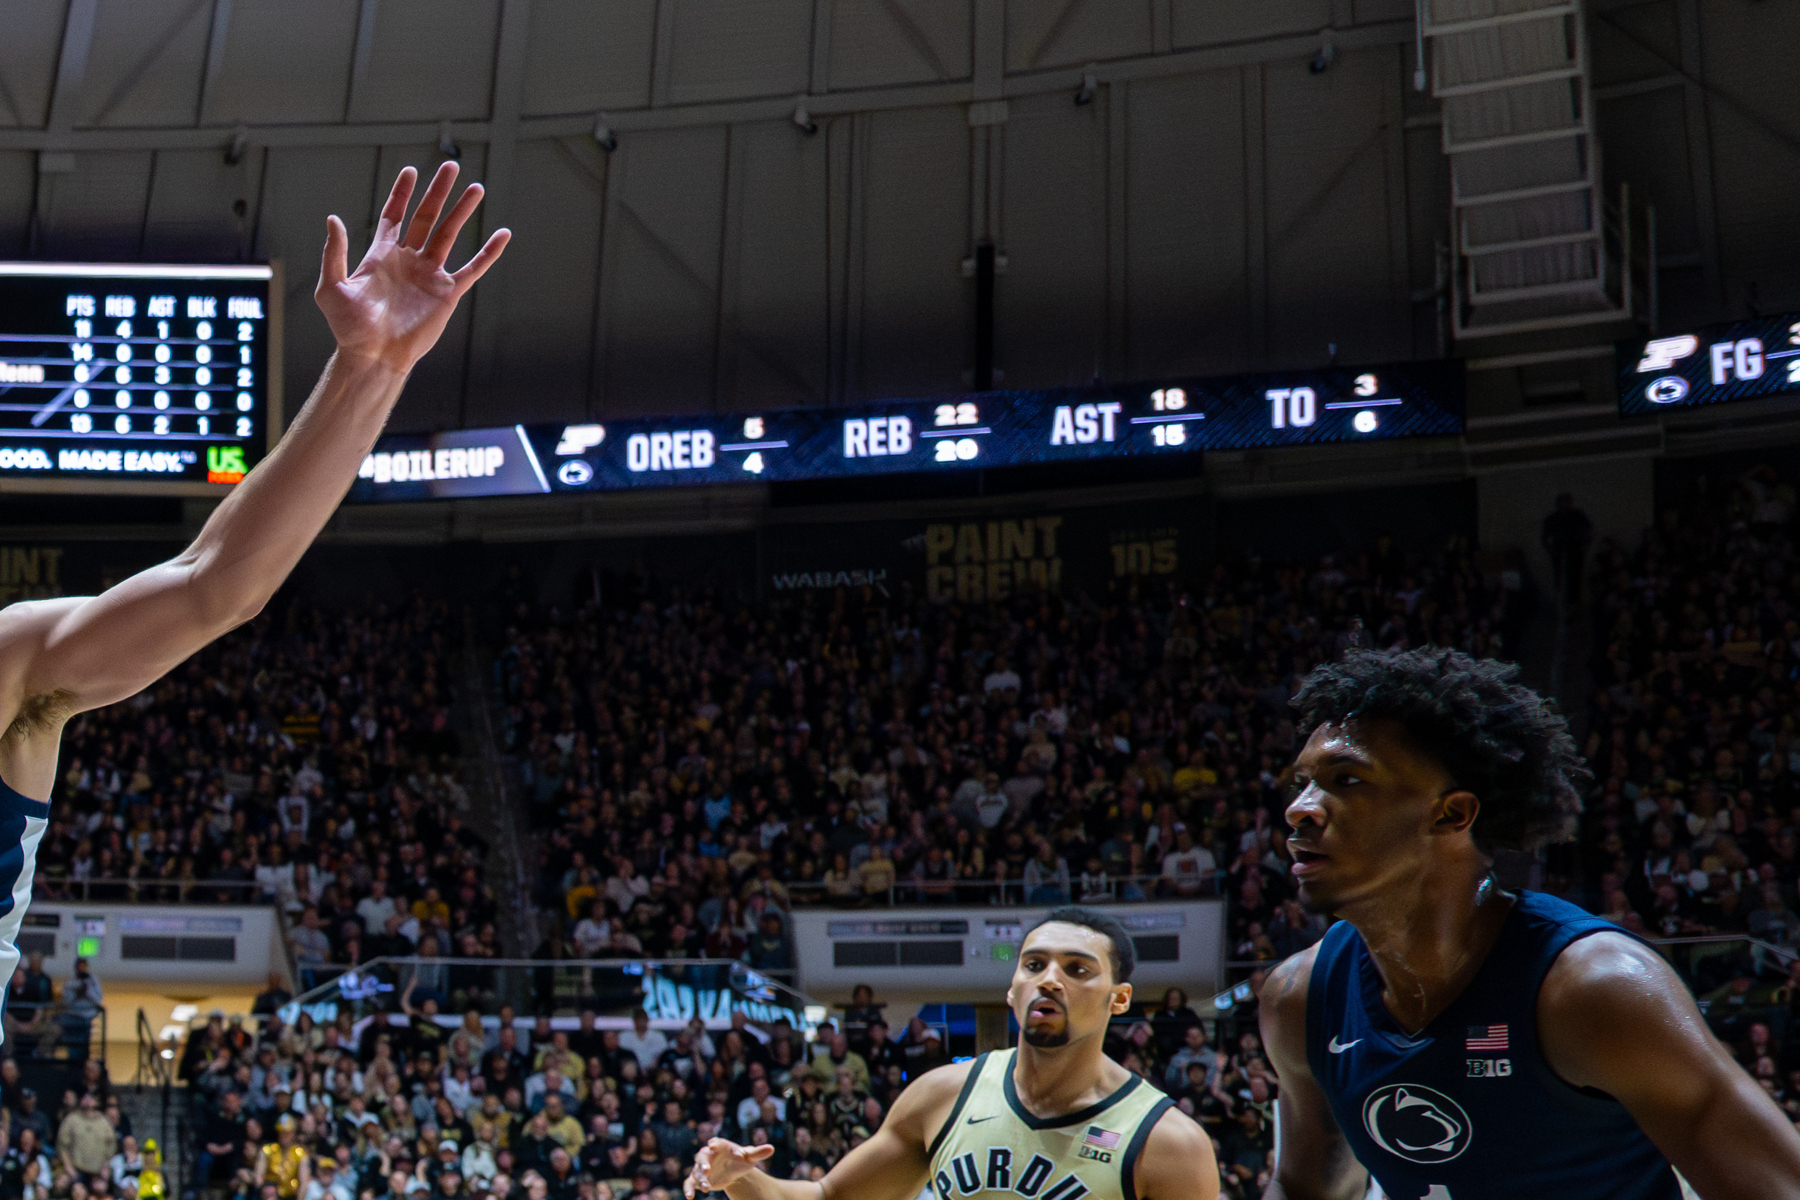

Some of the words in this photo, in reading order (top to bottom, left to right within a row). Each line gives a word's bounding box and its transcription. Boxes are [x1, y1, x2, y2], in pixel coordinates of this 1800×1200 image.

[67, 294, 96, 317] PTS
[105, 295, 136, 317] REB
[148, 295, 177, 318] AST
[187, 296, 217, 318] BLK
[228, 296, 264, 319] FOUL
[74, 319, 92, 338] 11
[116, 320, 132, 339] 4
[157, 320, 169, 339] 1
[196, 321, 212, 340] 0
[237, 321, 254, 341] 2
[71, 342, 93, 361] 14
[116, 343, 132, 363] 0
[155, 344, 171, 363] 0
[196, 344, 212, 364] 0
[239, 345, 250, 364] 1
[1710, 337, 1763, 386] FG
[74, 363, 90, 383] 6
[115, 365, 131, 384] 6
[155, 365, 170, 385] 3
[195, 366, 211, 385] 0
[237, 367, 253, 387] 2
[1354, 374, 1377, 397] 3
[74, 388, 90, 408] 0
[115, 389, 132, 409] 0
[154, 390, 170, 410] 0
[195, 391, 211, 410] 0
[236, 391, 253, 411] 0
[1151, 389, 1186, 411] 18
[1266, 386, 1315, 429] TO
[115, 414, 131, 434] 6
[153, 415, 170, 435] 2
[197, 416, 209, 436] 1
[236, 416, 252, 436] 2
[935, 403, 978, 426] 22
[1050, 402, 1121, 446] AST
[1354, 411, 1377, 433] 6
[843, 416, 912, 459] REB
[1151, 423, 1186, 447] 15
[59, 449, 123, 471] MADE
[627, 429, 715, 472] OREB
[934, 438, 978, 462] 20
[742, 452, 764, 475] 4
[926, 516, 1063, 564] PAINT
